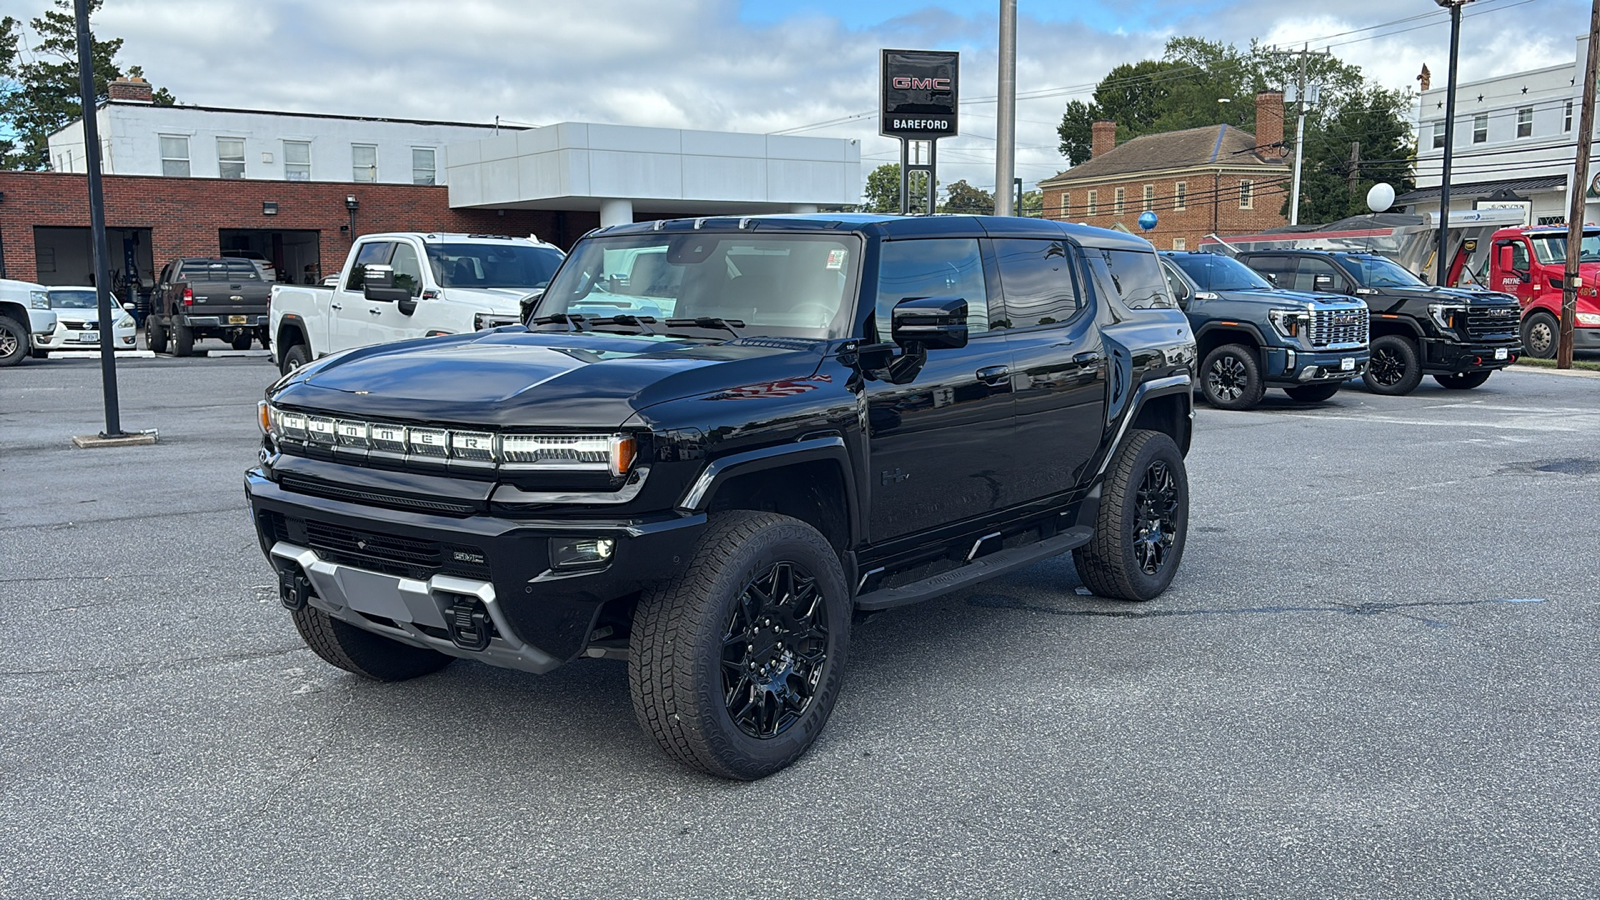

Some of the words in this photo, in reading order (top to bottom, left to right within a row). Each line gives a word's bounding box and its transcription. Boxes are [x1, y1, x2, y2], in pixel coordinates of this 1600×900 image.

[893, 77, 951, 90] GMC
[893, 119, 949, 130] BAREFORD
[1502, 277, 1520, 285] PAYNE
[287, 419, 478, 449] HUMMER
[454, 552, 484, 563] GMC
